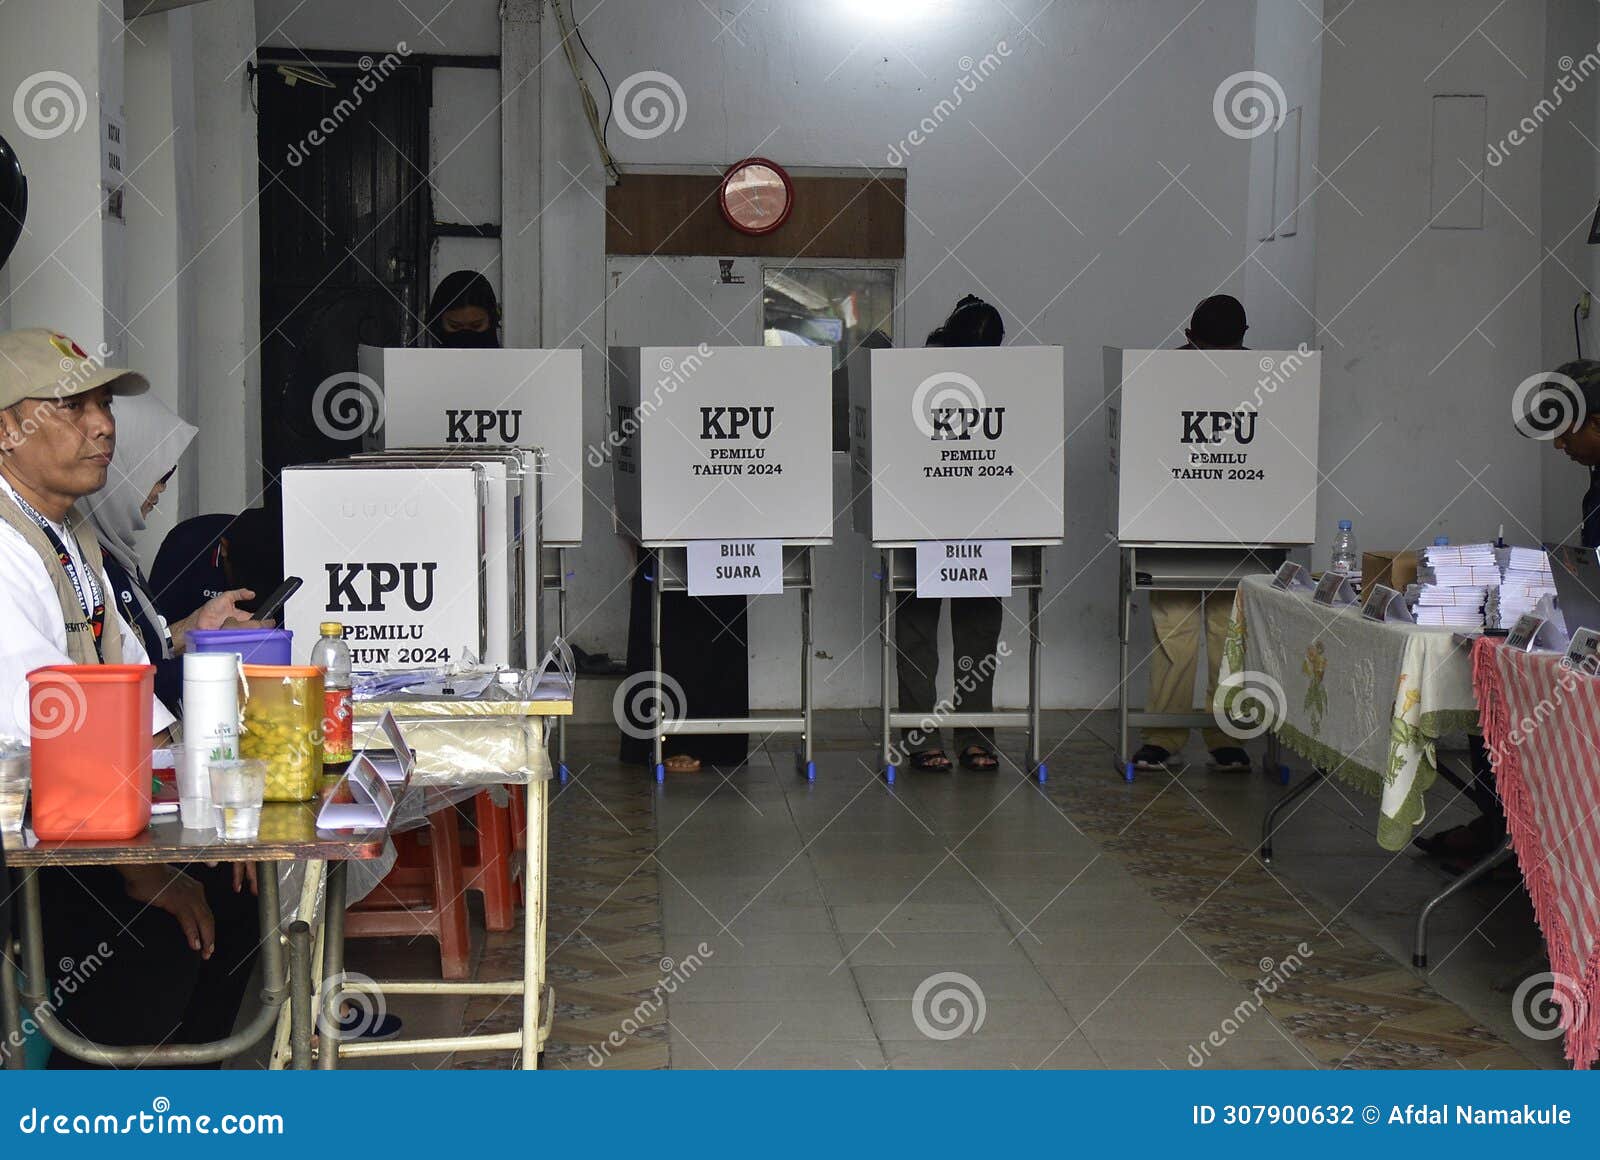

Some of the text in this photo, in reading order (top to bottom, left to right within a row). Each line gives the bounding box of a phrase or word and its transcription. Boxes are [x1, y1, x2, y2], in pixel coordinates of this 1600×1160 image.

[445, 409, 523, 443] KPU
[699, 406, 775, 440] KPU
[930, 407, 1006, 441] KPU
[1180, 410, 1259, 445] KPU
[709, 448, 766, 459] PEMILU
[940, 449, 996, 461] PEMILU
[1190, 453, 1248, 465] PEMILU
[692, 463, 783, 476] TAHUN 2024
[923, 465, 1014, 478] TAHUN 2024
[1171, 468, 1265, 481] TAHUN 2024
[720, 543, 756, 557] BILIK
[946, 544, 983, 559] BILIK
[715, 565, 761, 580] SUARA
[940, 567, 989, 583] SUARA
[65, 563, 87, 611] BAWASLU
[325, 562, 437, 612] KPU
[341, 624, 424, 641] PEMILU
[348, 647, 451, 664] HUN 2024
